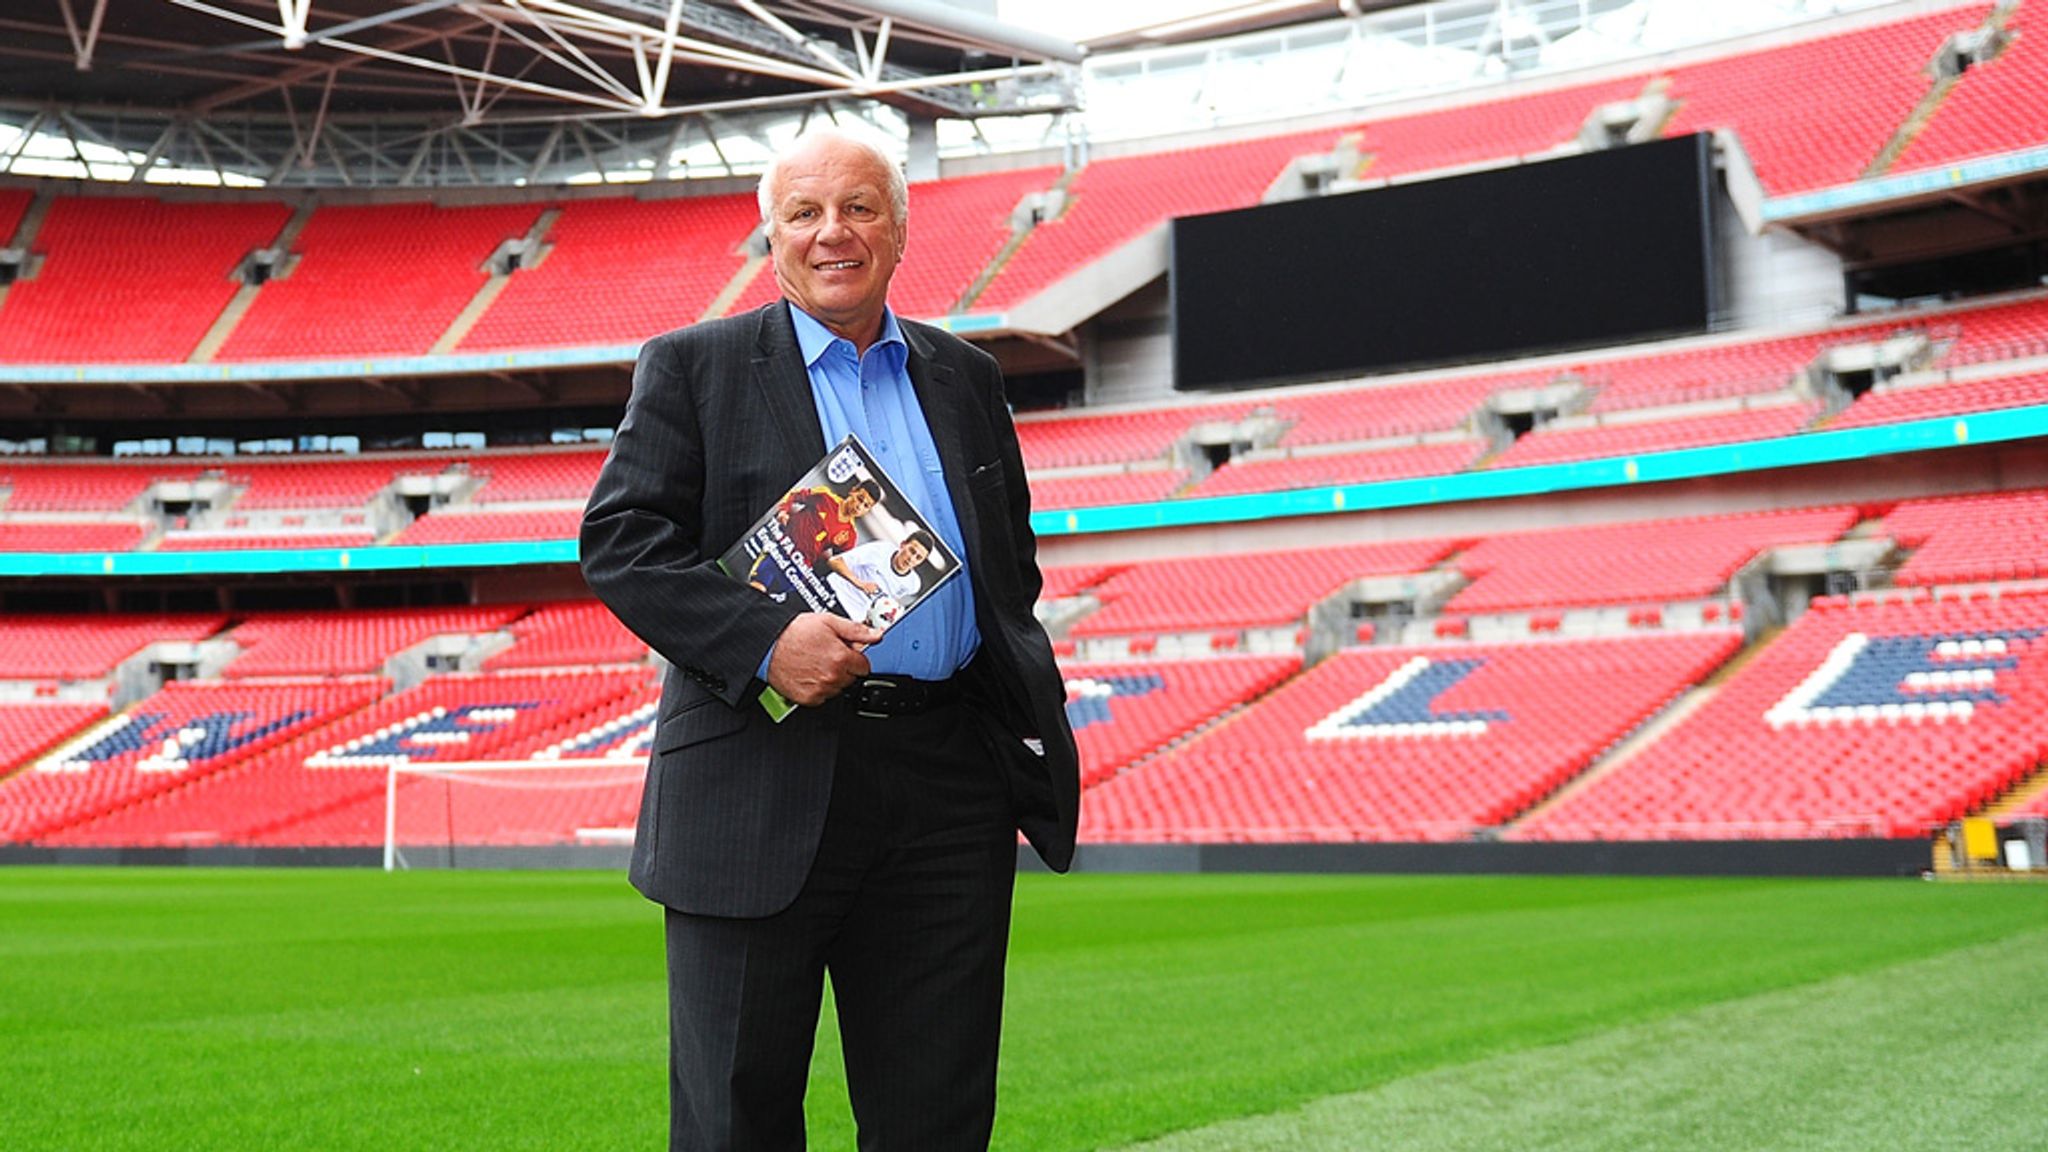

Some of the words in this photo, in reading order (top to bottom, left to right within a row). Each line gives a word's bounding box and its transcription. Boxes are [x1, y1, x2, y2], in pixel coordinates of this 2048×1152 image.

[756, 527, 790, 570] England
[767, 518, 784, 540] The
[780, 536, 795, 554] FA
[790, 551, 836, 608] Chairman's
